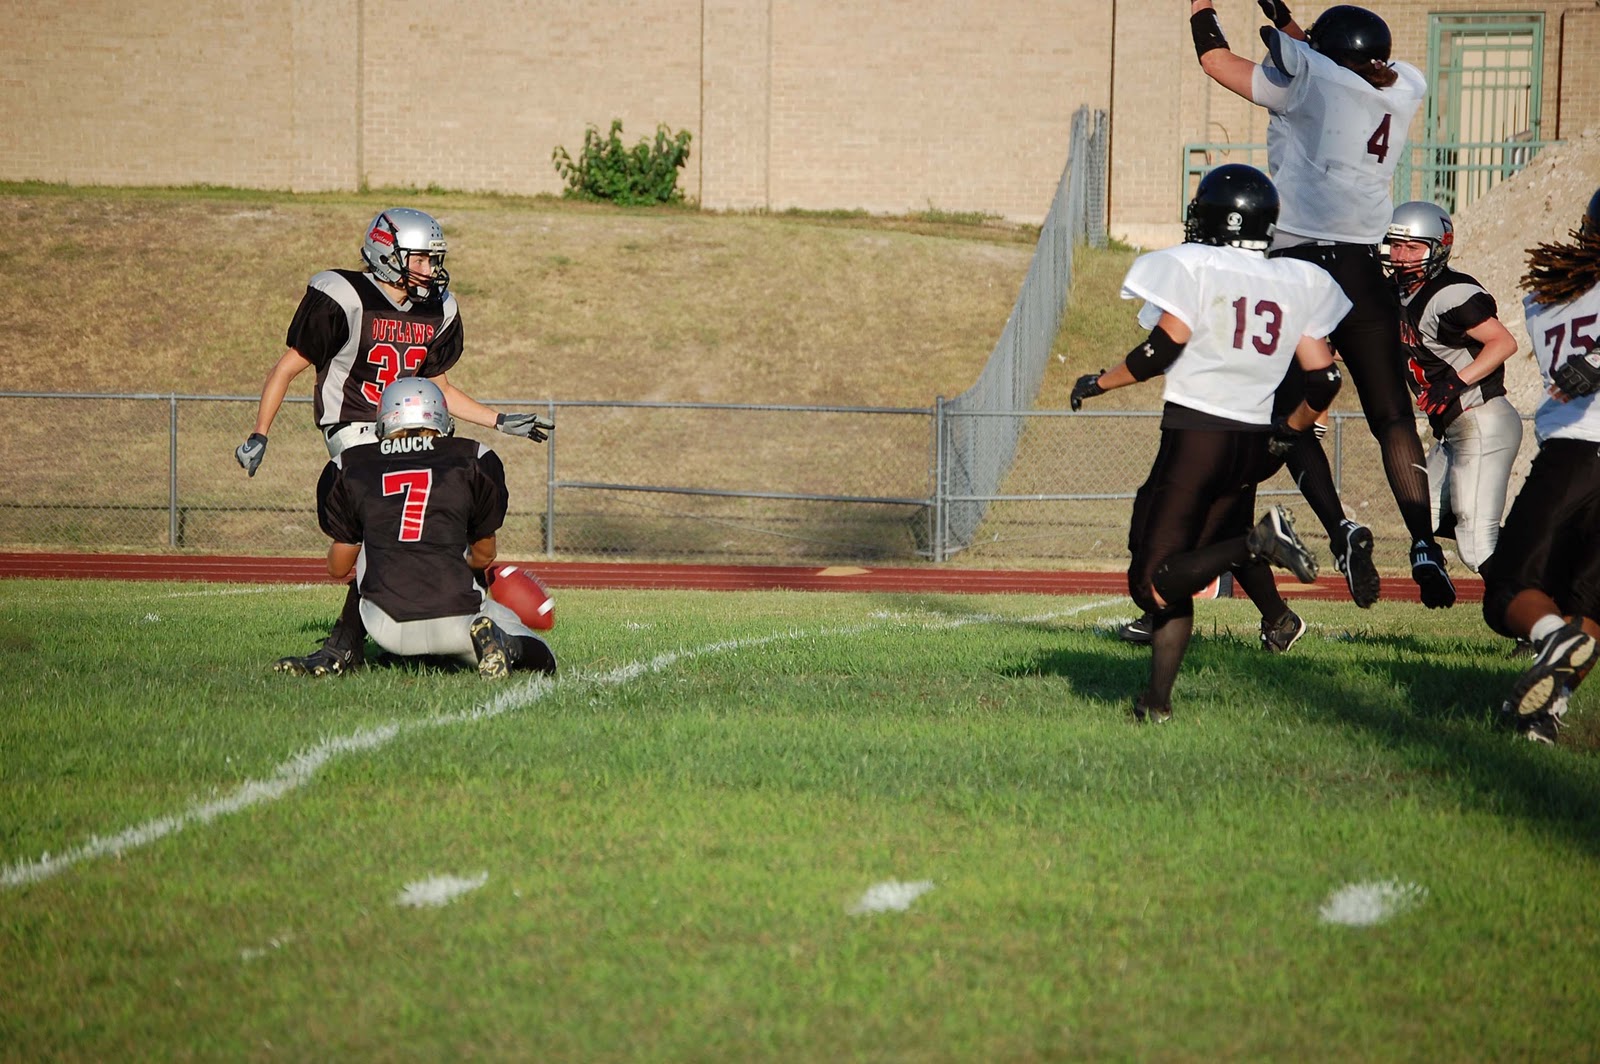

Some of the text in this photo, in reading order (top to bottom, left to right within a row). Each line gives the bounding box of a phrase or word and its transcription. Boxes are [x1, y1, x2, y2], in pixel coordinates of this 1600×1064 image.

[1367, 113, 1392, 164] 4
[372, 318, 434, 344] OUTLAWS
[1232, 296, 1283, 356] 13
[1544, 312, 1599, 376] 75
[380, 436, 435, 455] GAUCK
[382, 468, 432, 542] 7
